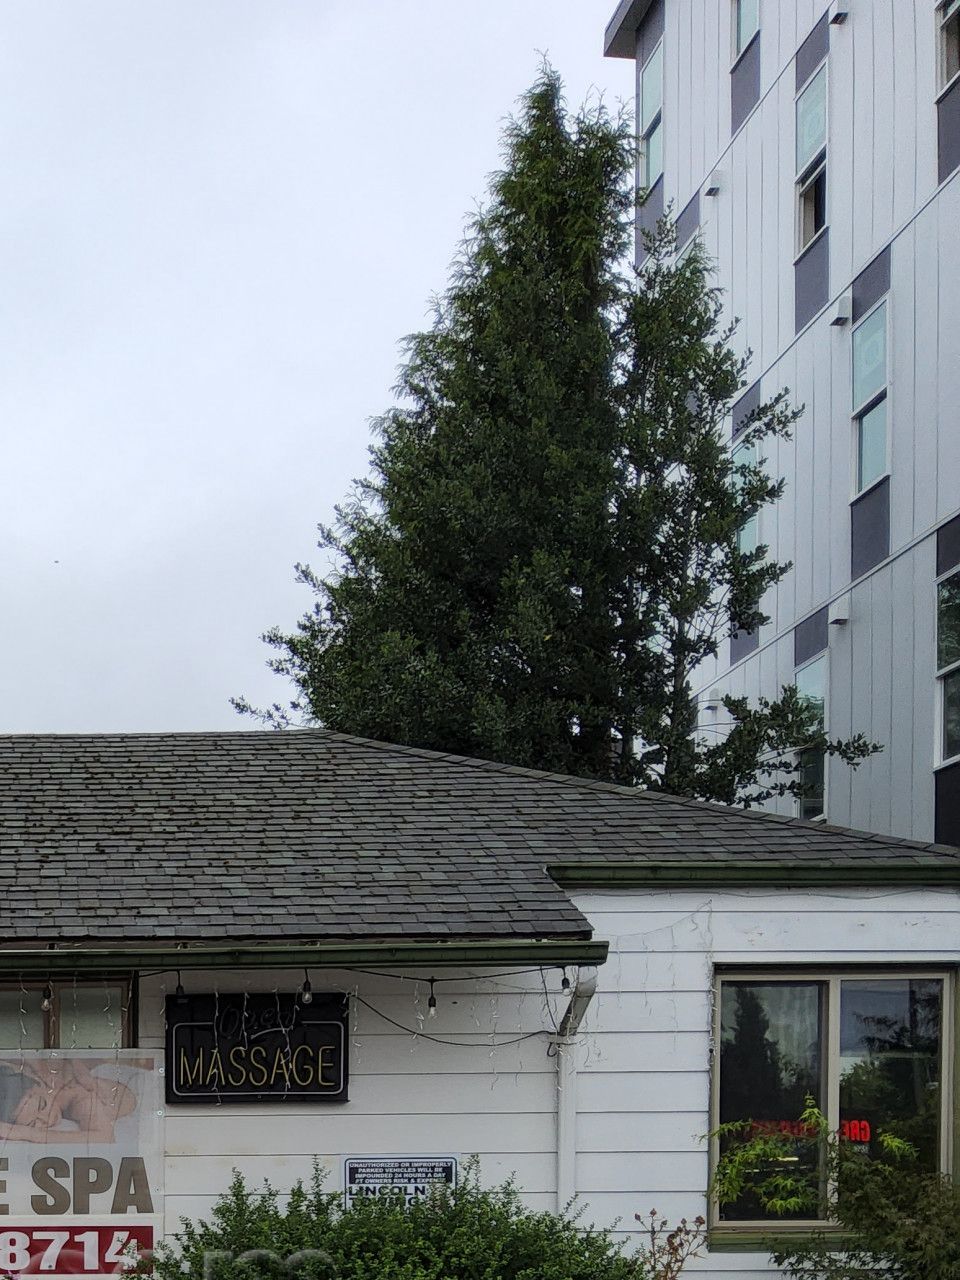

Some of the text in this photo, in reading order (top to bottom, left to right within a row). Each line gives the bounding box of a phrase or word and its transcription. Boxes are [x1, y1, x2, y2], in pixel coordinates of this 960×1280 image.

[180, 1044, 336, 1087] MASSAGE
[30, 1156, 154, 1215] SPA
[348, 1185, 426, 1196] LINCOLN
